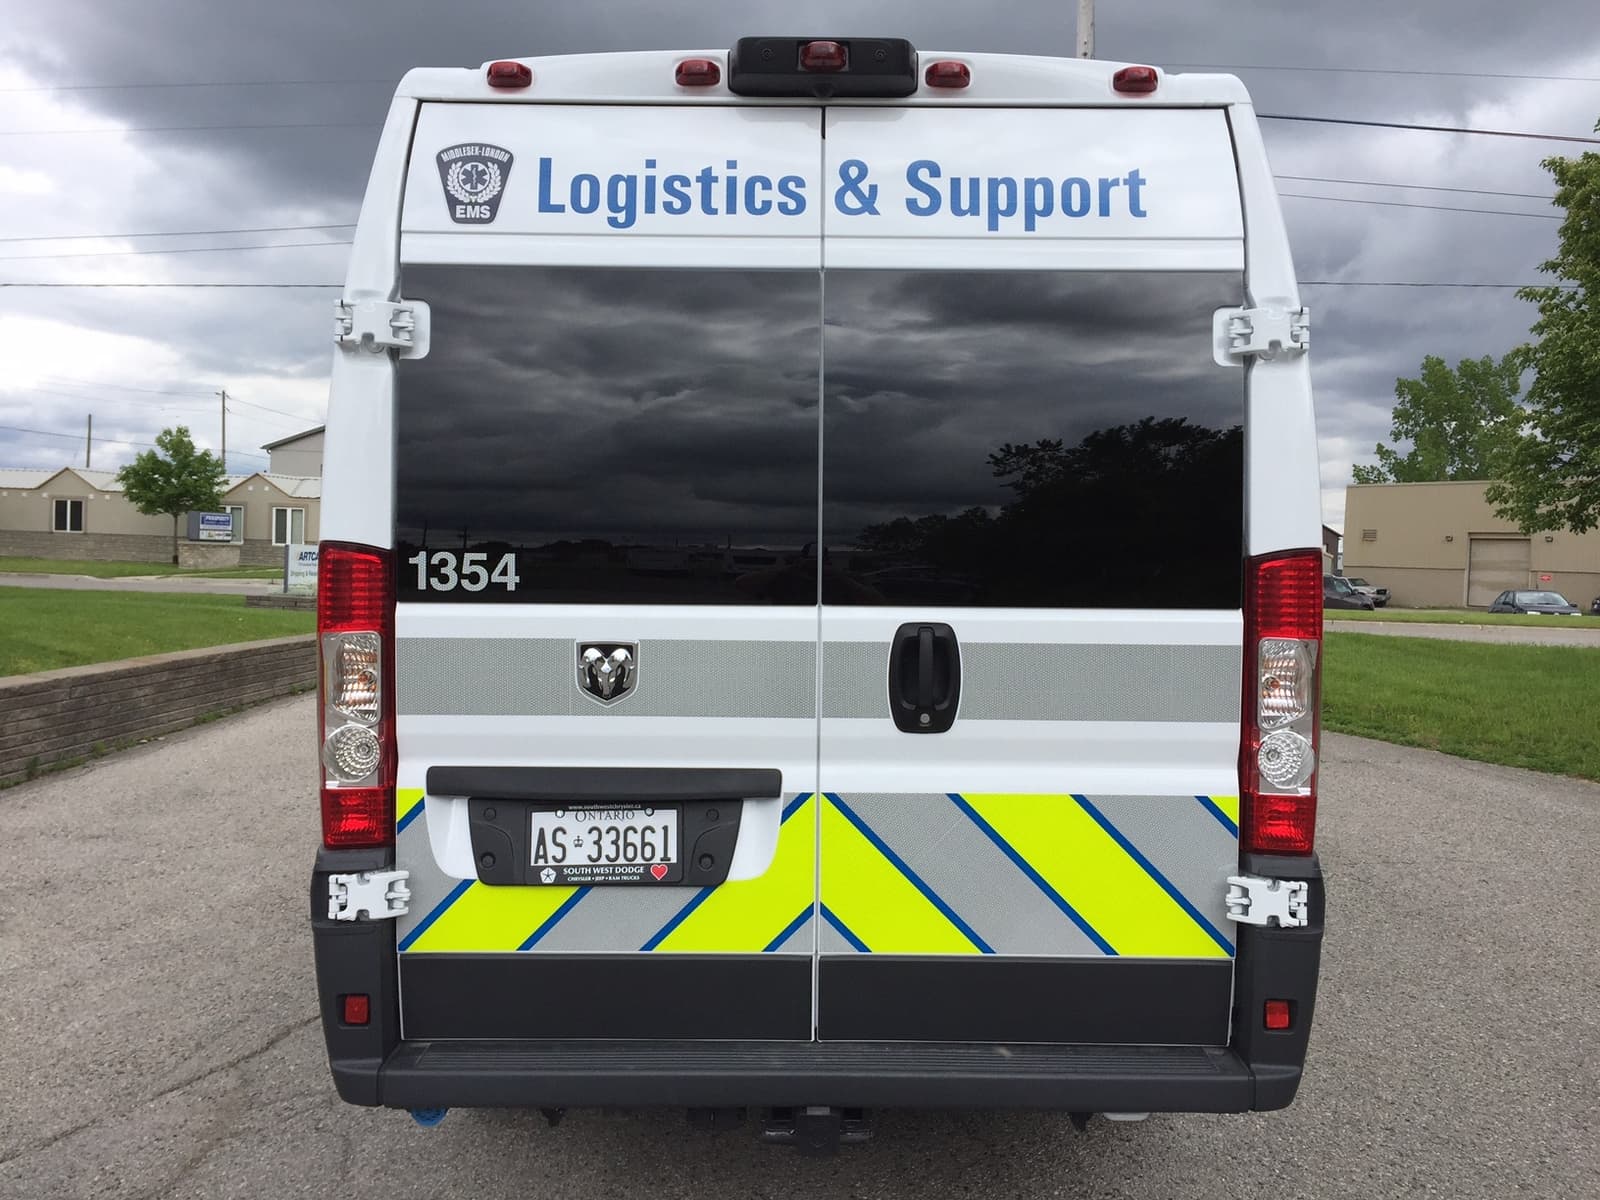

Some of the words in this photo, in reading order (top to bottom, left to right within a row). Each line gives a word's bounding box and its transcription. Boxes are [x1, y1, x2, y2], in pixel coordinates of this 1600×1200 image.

[440, 145, 511, 162] MIDDLESEX-LONDON
[538, 157, 807, 229] Logistics
[834, 159, 881, 216] &
[905, 159, 1147, 232] Support
[455, 204, 491, 219] EMS
[408, 551, 520, 592] 1354
[575, 810, 635, 822] ONTARIO
[533, 826, 567, 864] AS
[587, 825, 671, 863] 33661
[563, 867, 591, 875] SOUTH
[592, 866, 614, 874] WEST
[615, 866, 644, 874] DODGE
